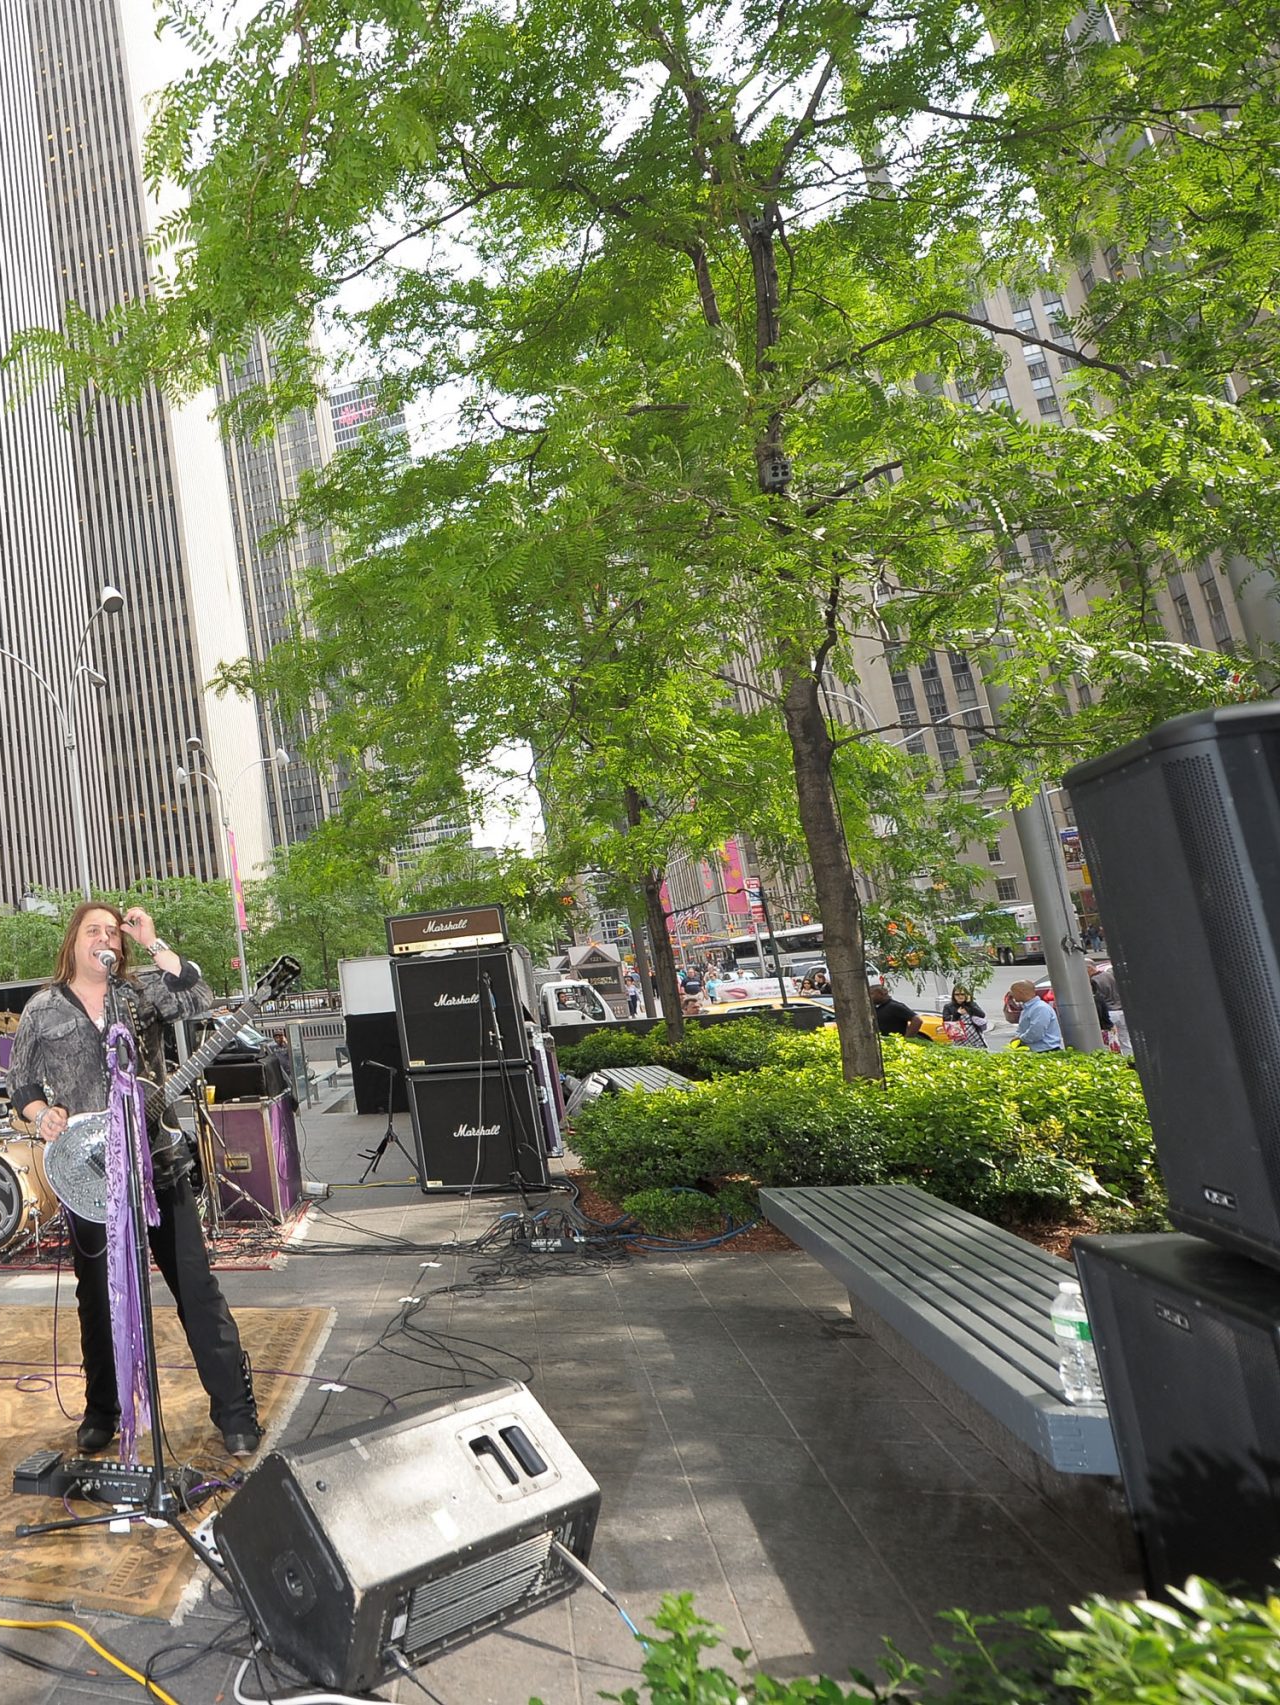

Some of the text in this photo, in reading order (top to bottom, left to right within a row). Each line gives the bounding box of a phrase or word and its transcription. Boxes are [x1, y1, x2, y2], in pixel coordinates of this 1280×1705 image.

[422, 918, 468, 934] Marshall
[433, 993, 480, 1007] Marshall
[453, 1123, 501, 1138] Marshall
